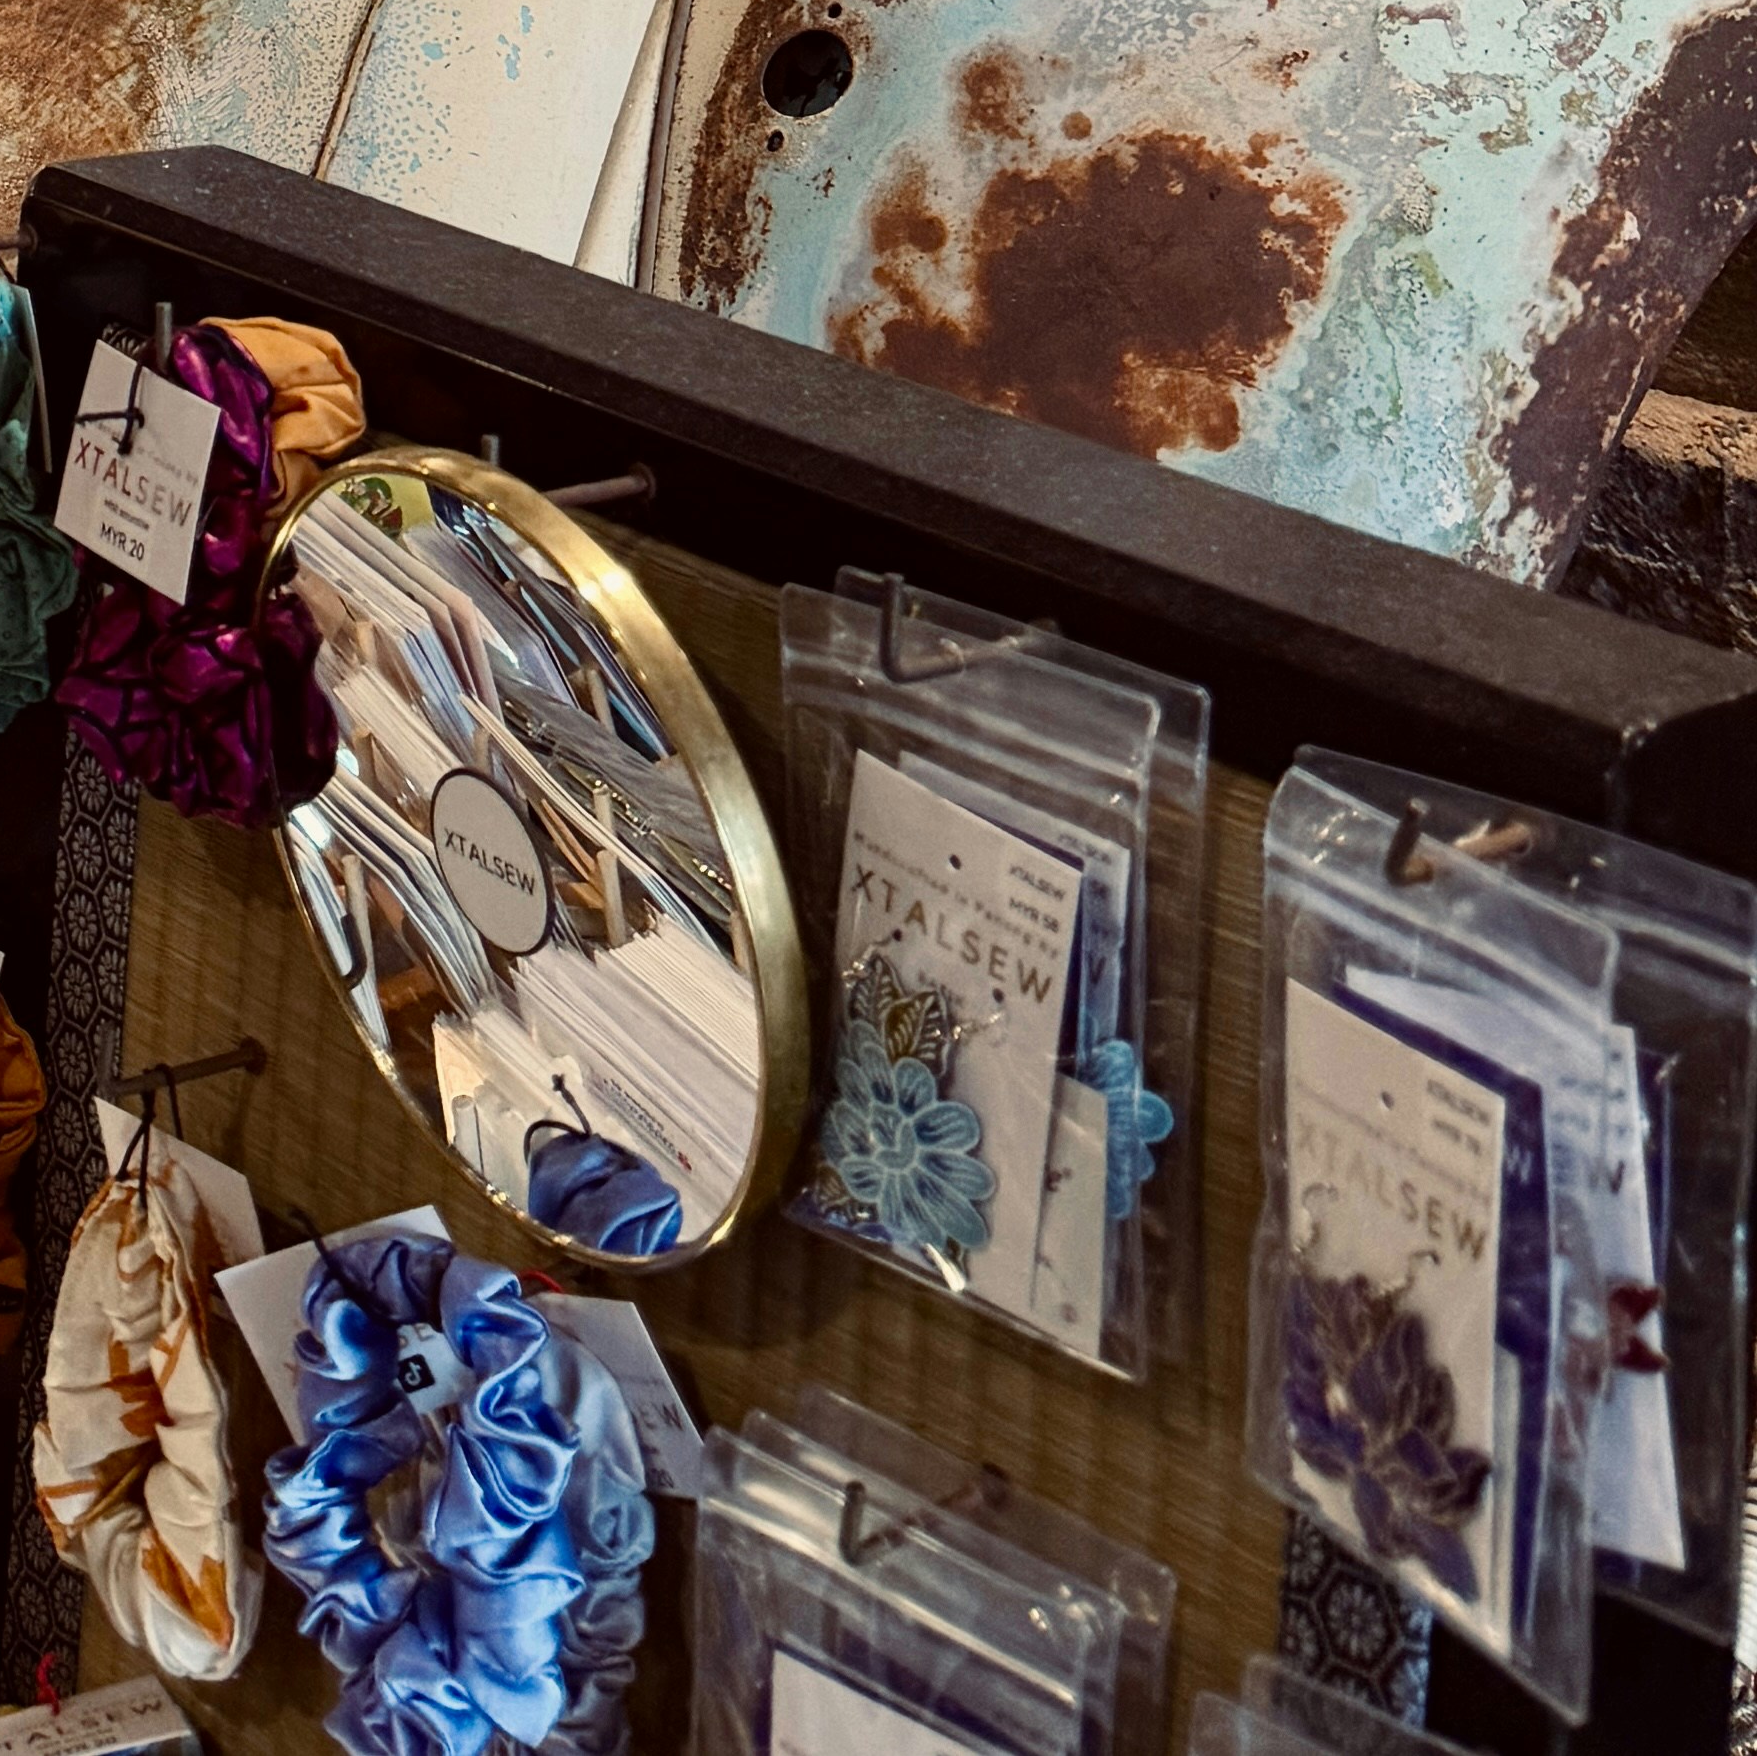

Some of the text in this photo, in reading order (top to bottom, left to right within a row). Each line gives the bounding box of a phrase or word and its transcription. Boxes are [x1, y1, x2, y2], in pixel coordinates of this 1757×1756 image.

[73, 436, 193, 529] XTALSEW
[100, 521, 146, 563] MYR 20
[444, 827, 536, 897] XTALSEW
[850, 861, 1053, 1006] XTALSEW
[1008, 896, 1040, 924] MYR
